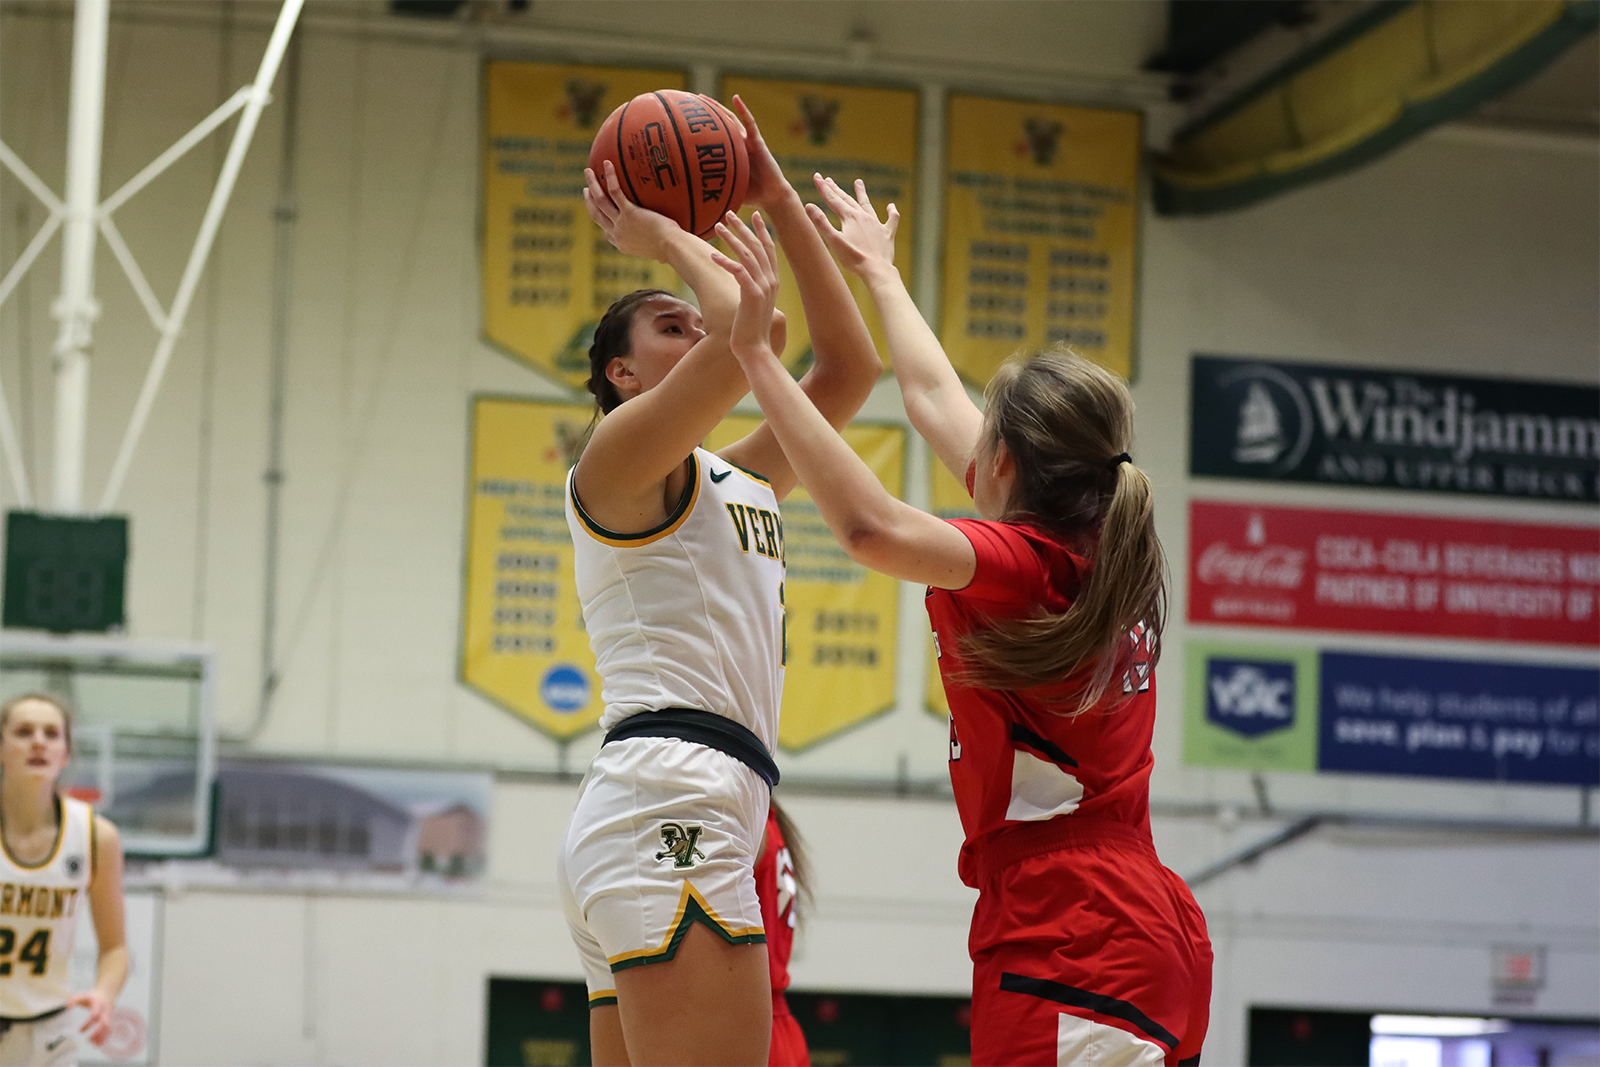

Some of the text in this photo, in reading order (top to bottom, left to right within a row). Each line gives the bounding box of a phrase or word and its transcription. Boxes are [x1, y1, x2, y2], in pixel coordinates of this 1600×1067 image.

[677, 96, 727, 203] THE ROCK
[1319, 454, 1385, 480] AND
[1316, 574, 1407, 608] PARTNER
[0, 926, 53, 976] 24
